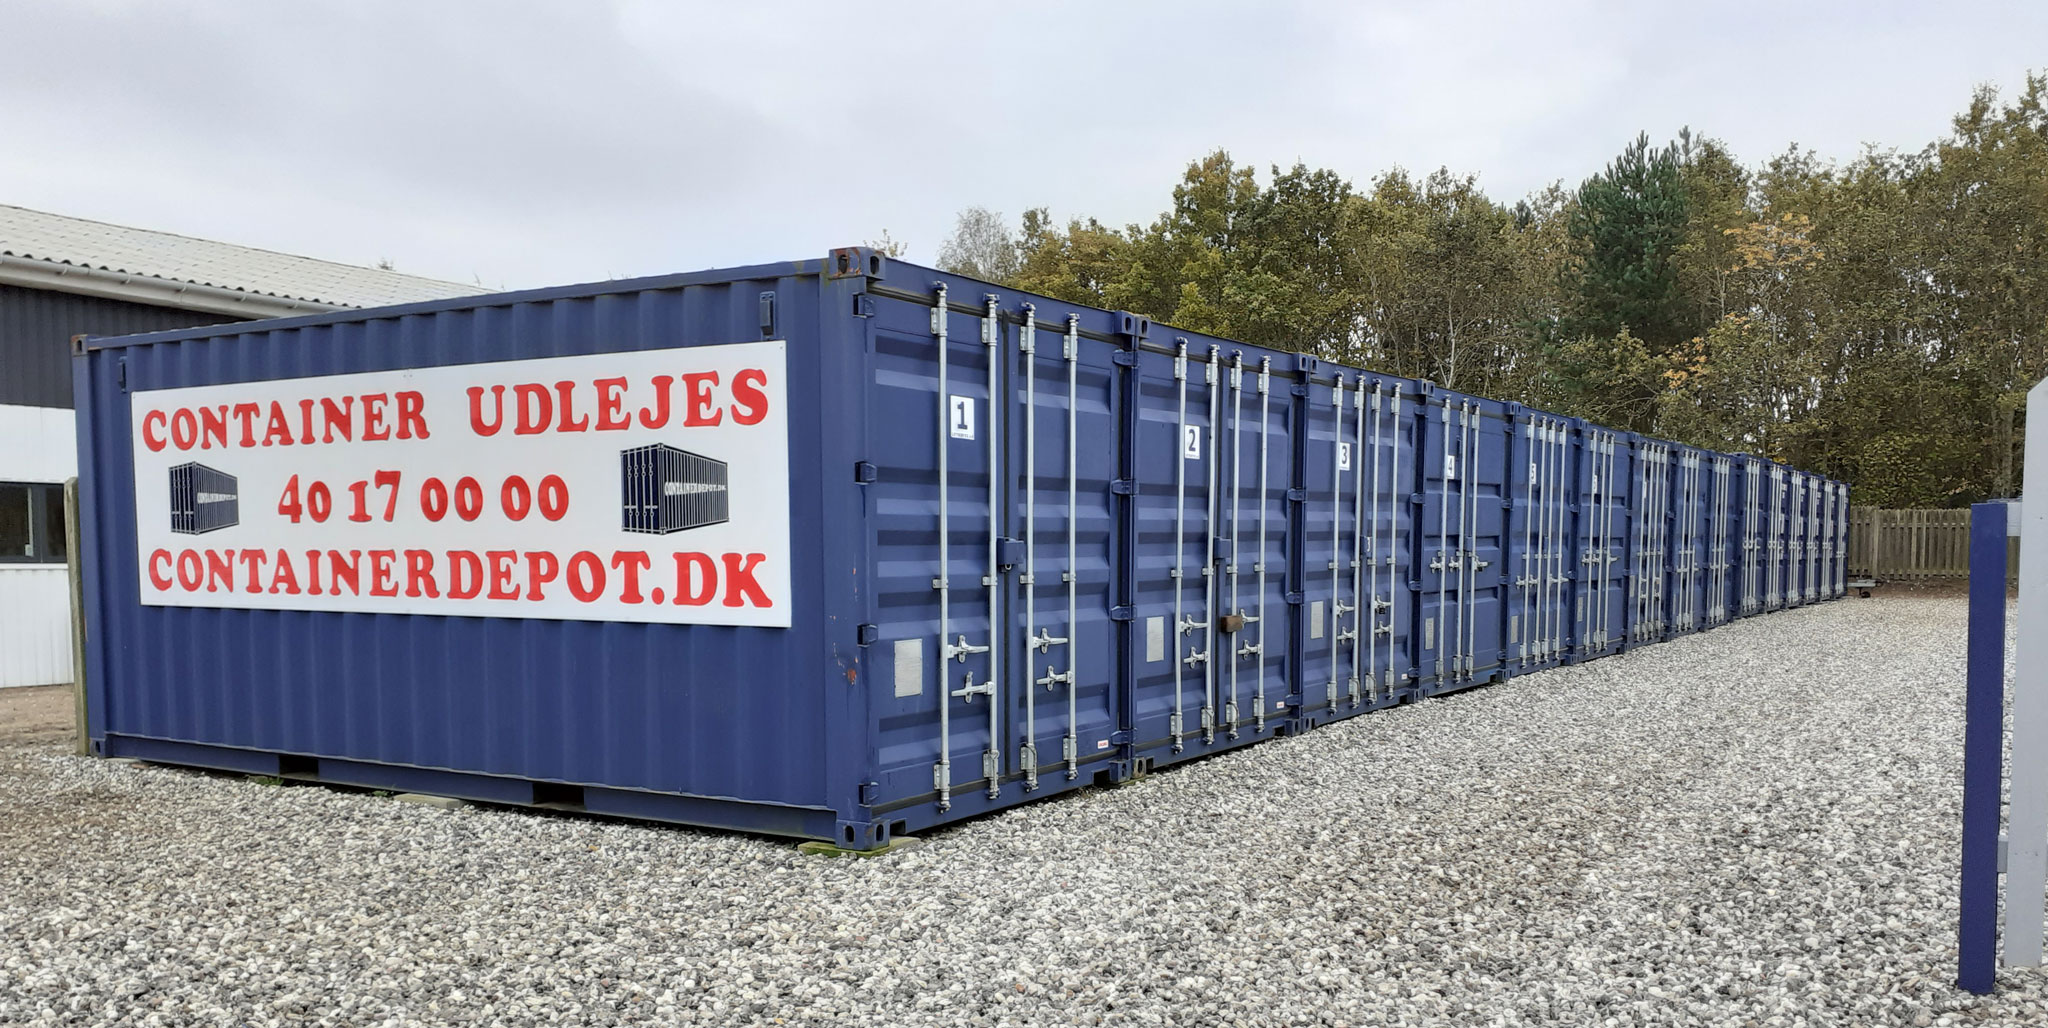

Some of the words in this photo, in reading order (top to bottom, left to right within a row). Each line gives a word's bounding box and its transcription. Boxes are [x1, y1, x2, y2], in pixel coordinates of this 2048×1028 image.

[142, 390, 430, 452] CONTAINER
[466, 368, 769, 437] UDLEJES
[957, 401, 968, 430] 1
[1188, 429, 1196, 452] 2
[1341, 445, 1348, 465] 3
[277, 473, 333, 524] 40
[347, 469, 401, 523] 17
[419, 475, 484, 522] 00
[500, 473, 570, 522] 00
[148, 548, 774, 609] CONTAINERDEPOT.DK
